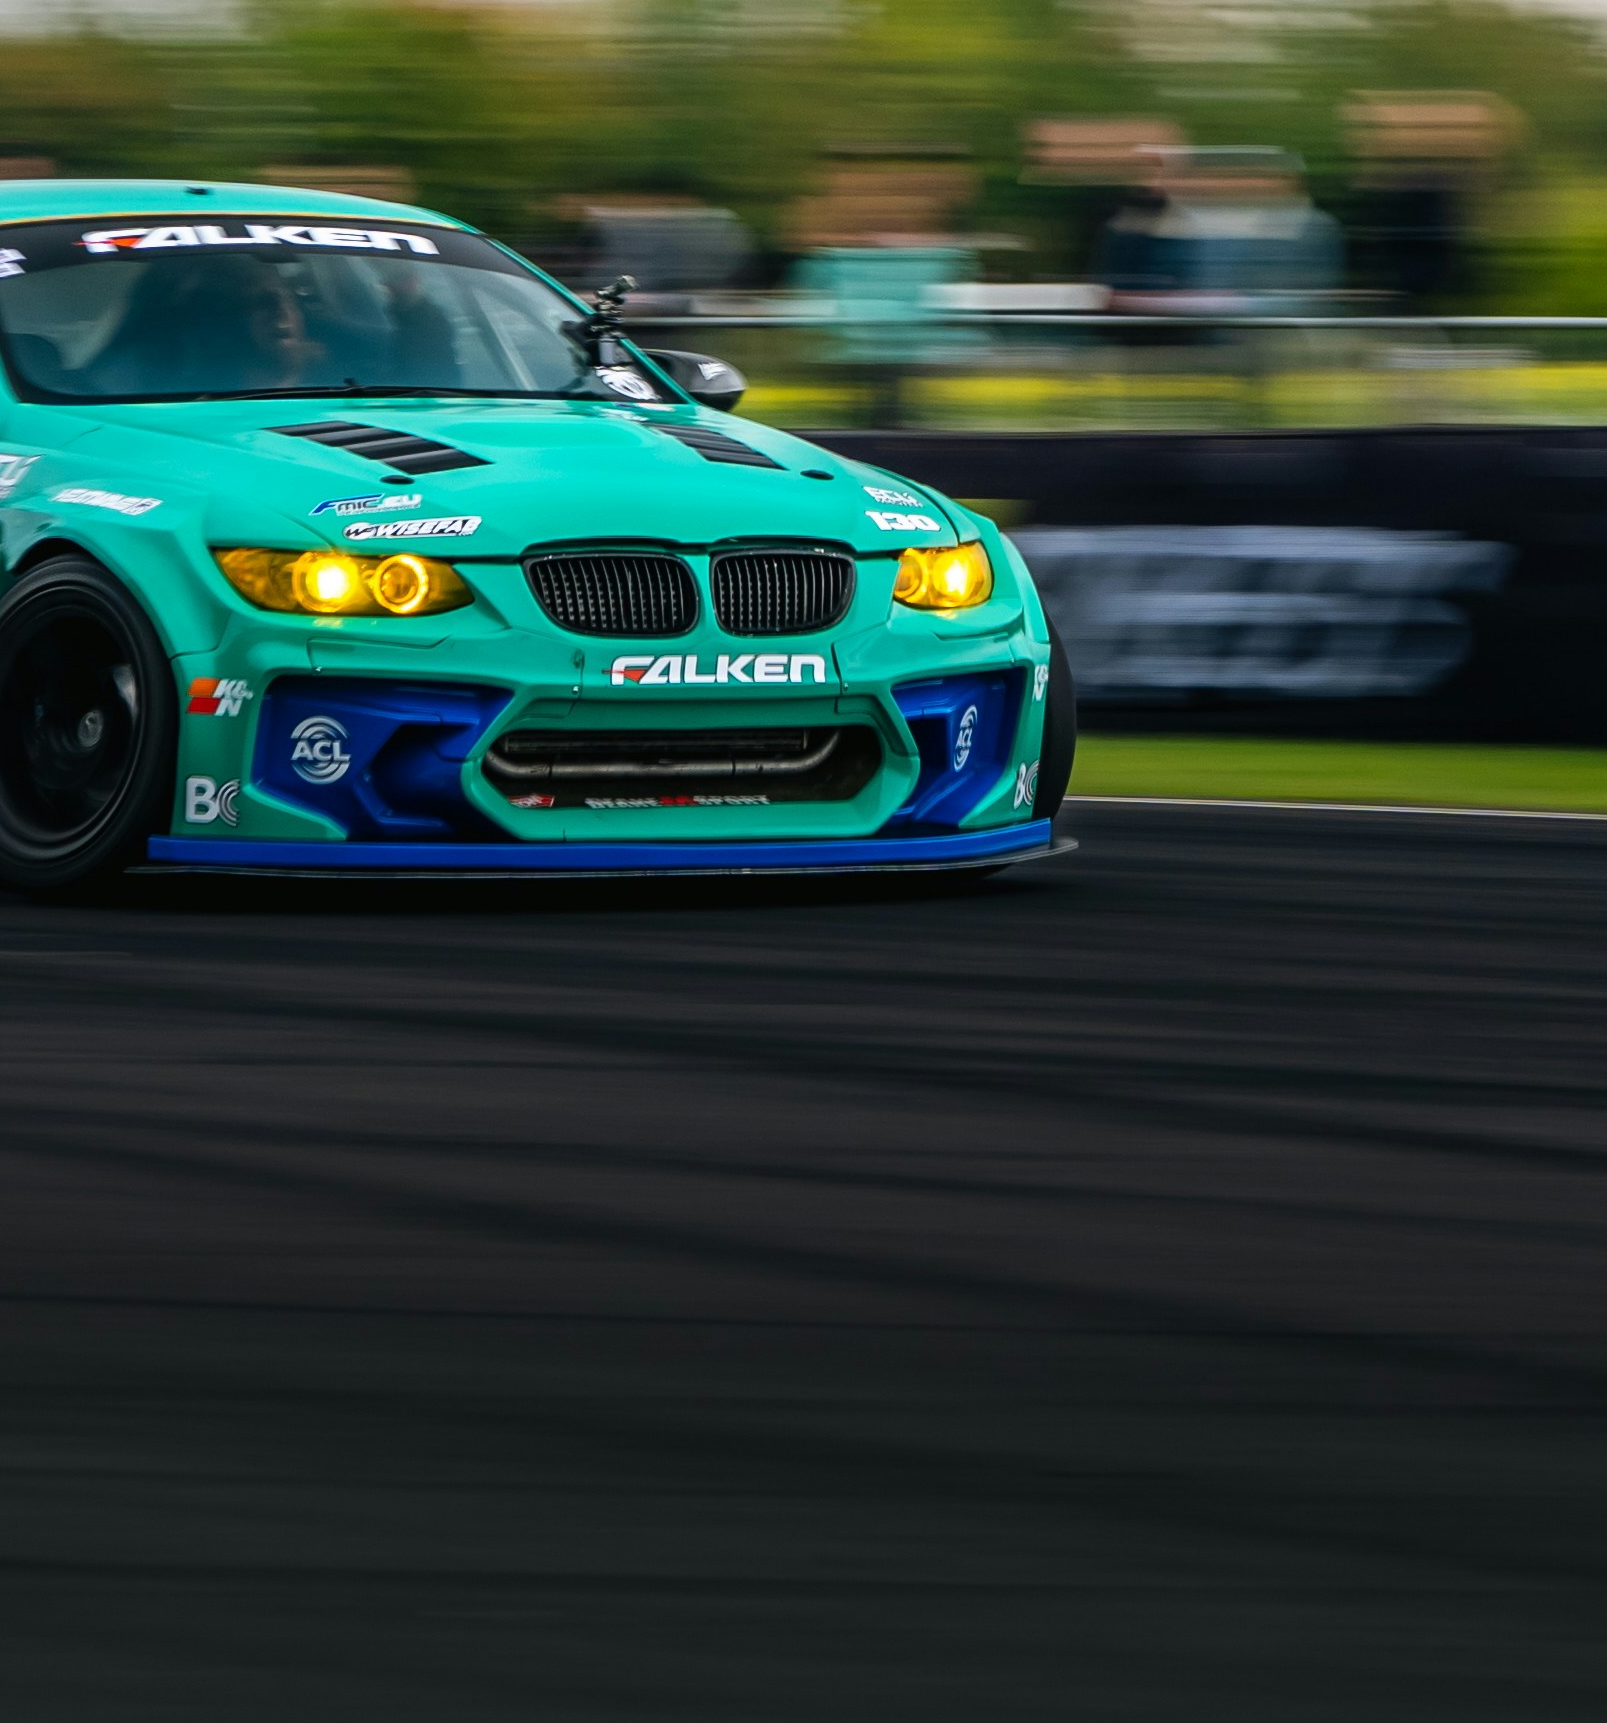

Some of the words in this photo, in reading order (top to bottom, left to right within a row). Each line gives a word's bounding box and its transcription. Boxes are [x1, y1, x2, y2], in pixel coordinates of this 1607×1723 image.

[81, 224, 440, 255] FALKEN
[864, 510, 941, 532] 130
[610, 653, 826, 686] FALKEN
[290, 739, 352, 761] ACL
